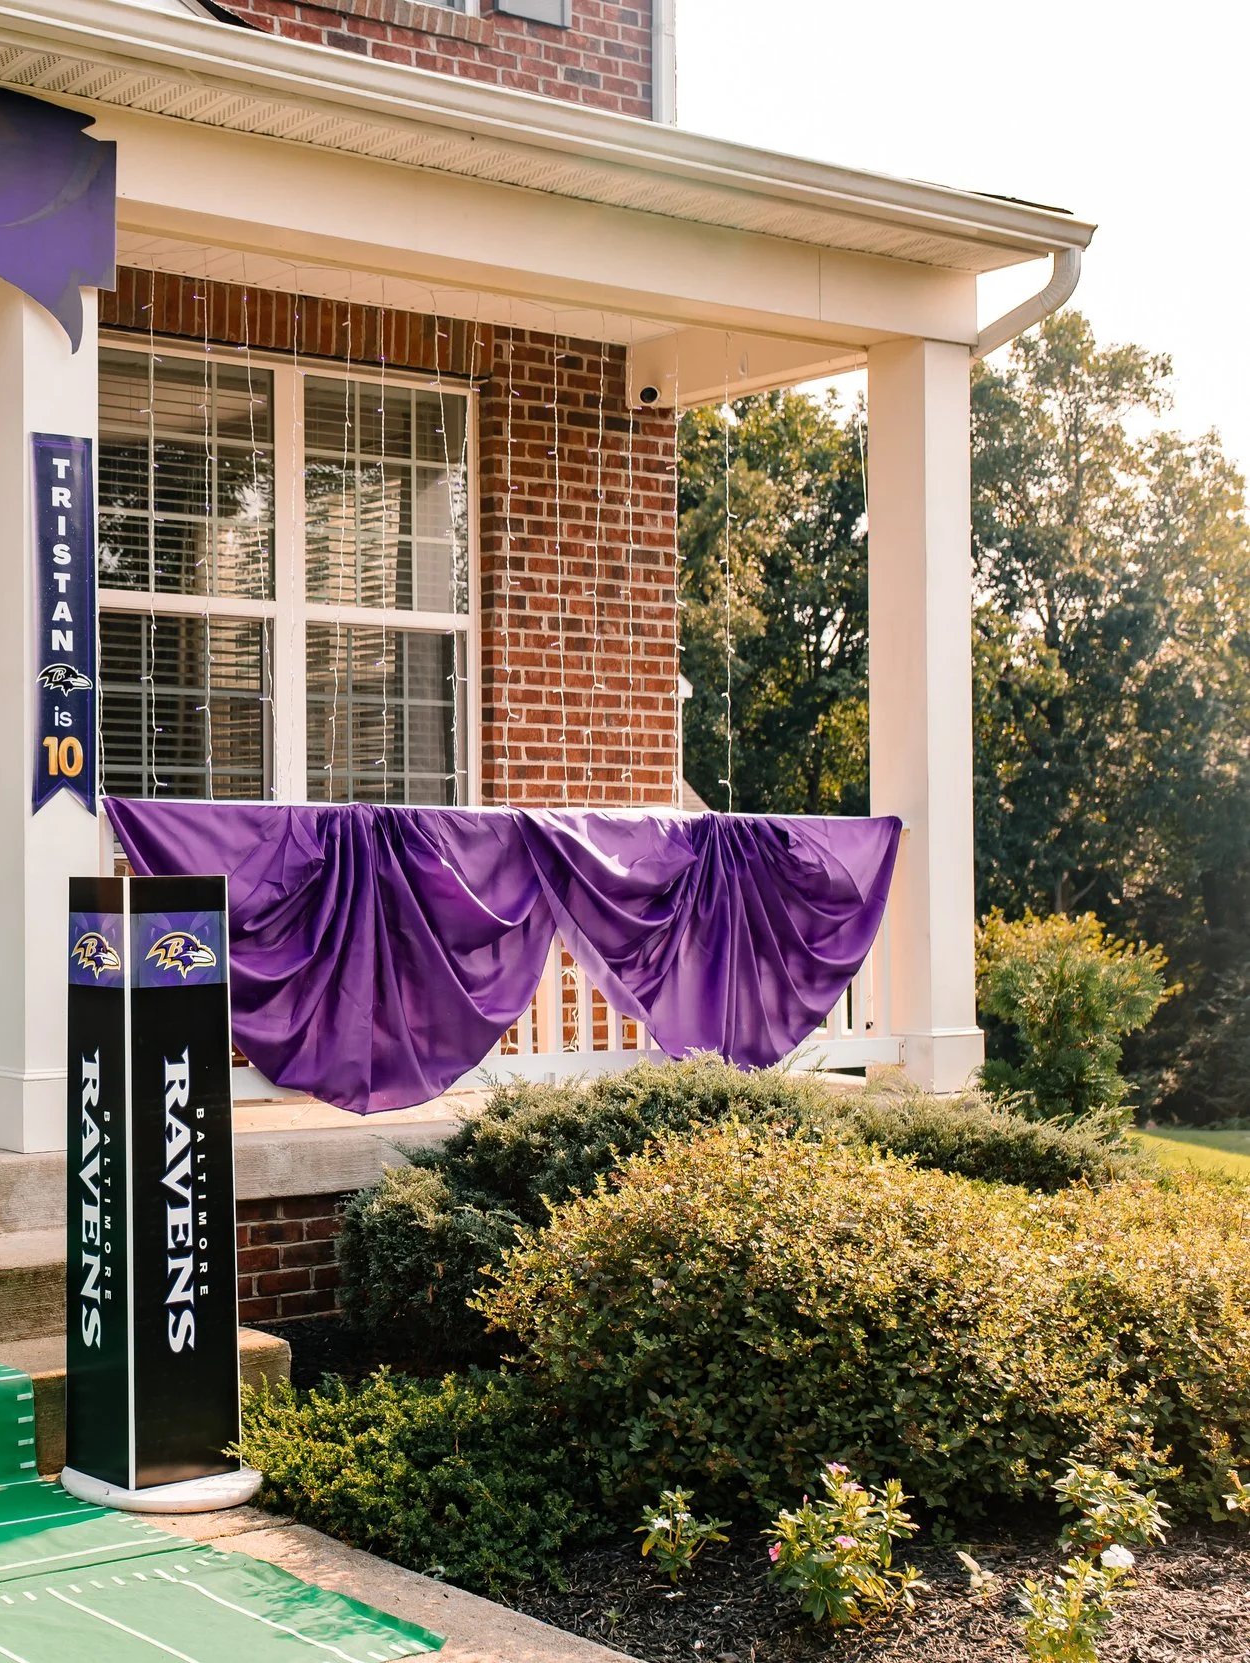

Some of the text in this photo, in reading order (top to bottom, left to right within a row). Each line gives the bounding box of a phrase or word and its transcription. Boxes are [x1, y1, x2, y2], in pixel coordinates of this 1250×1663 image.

[51, 457, 74, 652] TRISTAN
[42, 735, 84, 778] 10
[54, 705, 73, 727] is
[77, 1047, 102, 1350] RAVENS
[102, 1110, 113, 1301] BALTIMORE
[159, 1045, 196, 1354] RAVENS
[195, 1107, 209, 1297] BALTIMORE
